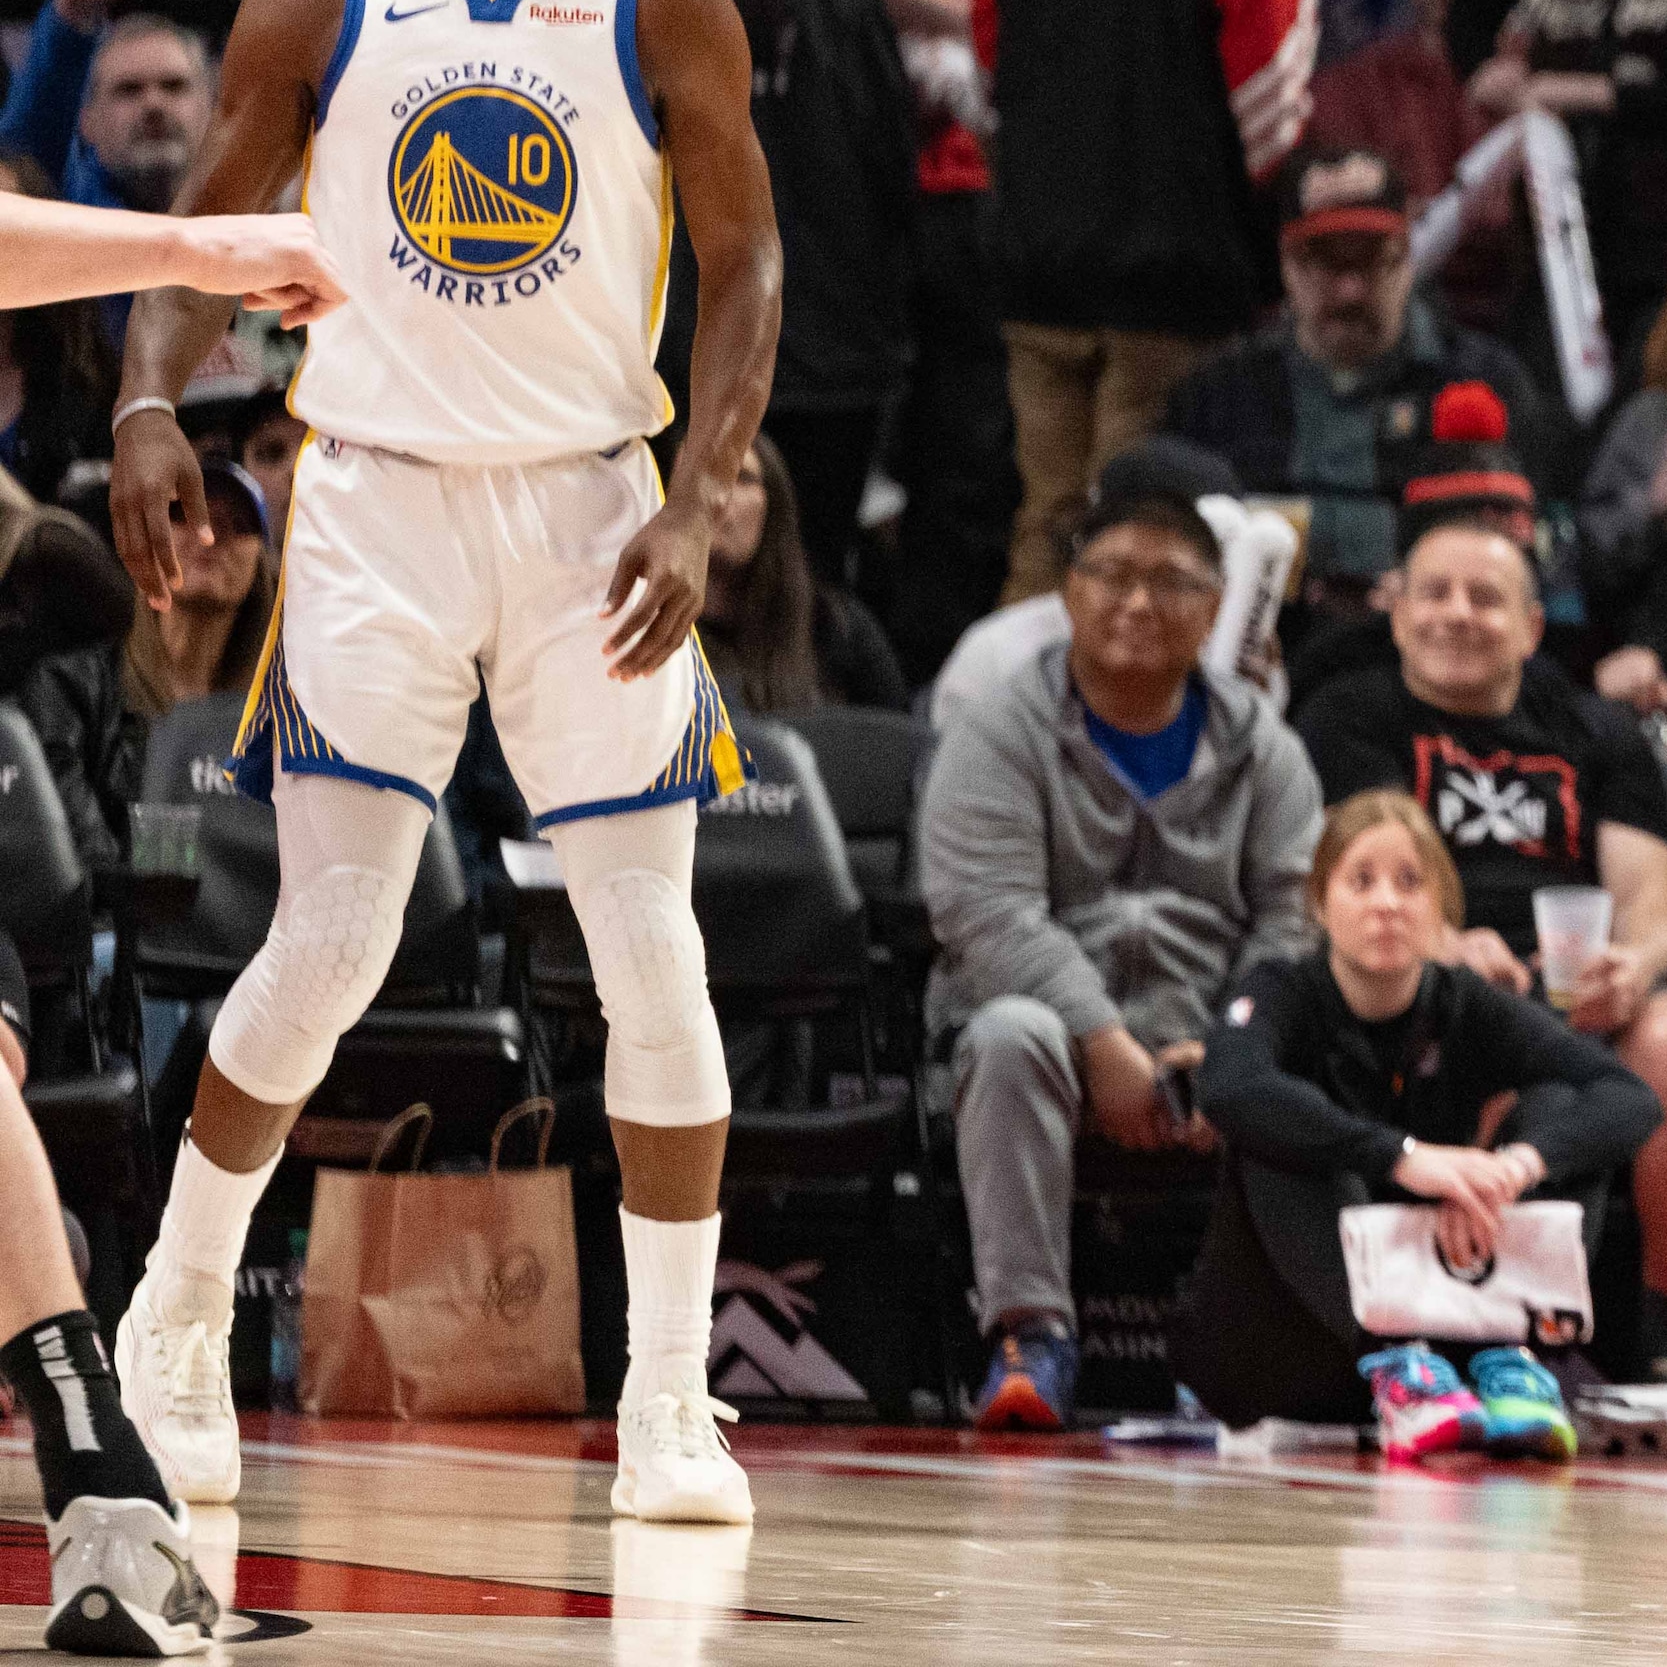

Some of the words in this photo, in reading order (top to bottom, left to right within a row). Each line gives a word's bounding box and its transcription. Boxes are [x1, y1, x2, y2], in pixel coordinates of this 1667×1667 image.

[529, 3, 604, 25] Rakuten
[391, 61, 496, 120] GOLDEN
[513, 66, 580, 127] STATE
[507, 133, 550, 187] 10
[389, 233, 581, 307] WARRIORS
